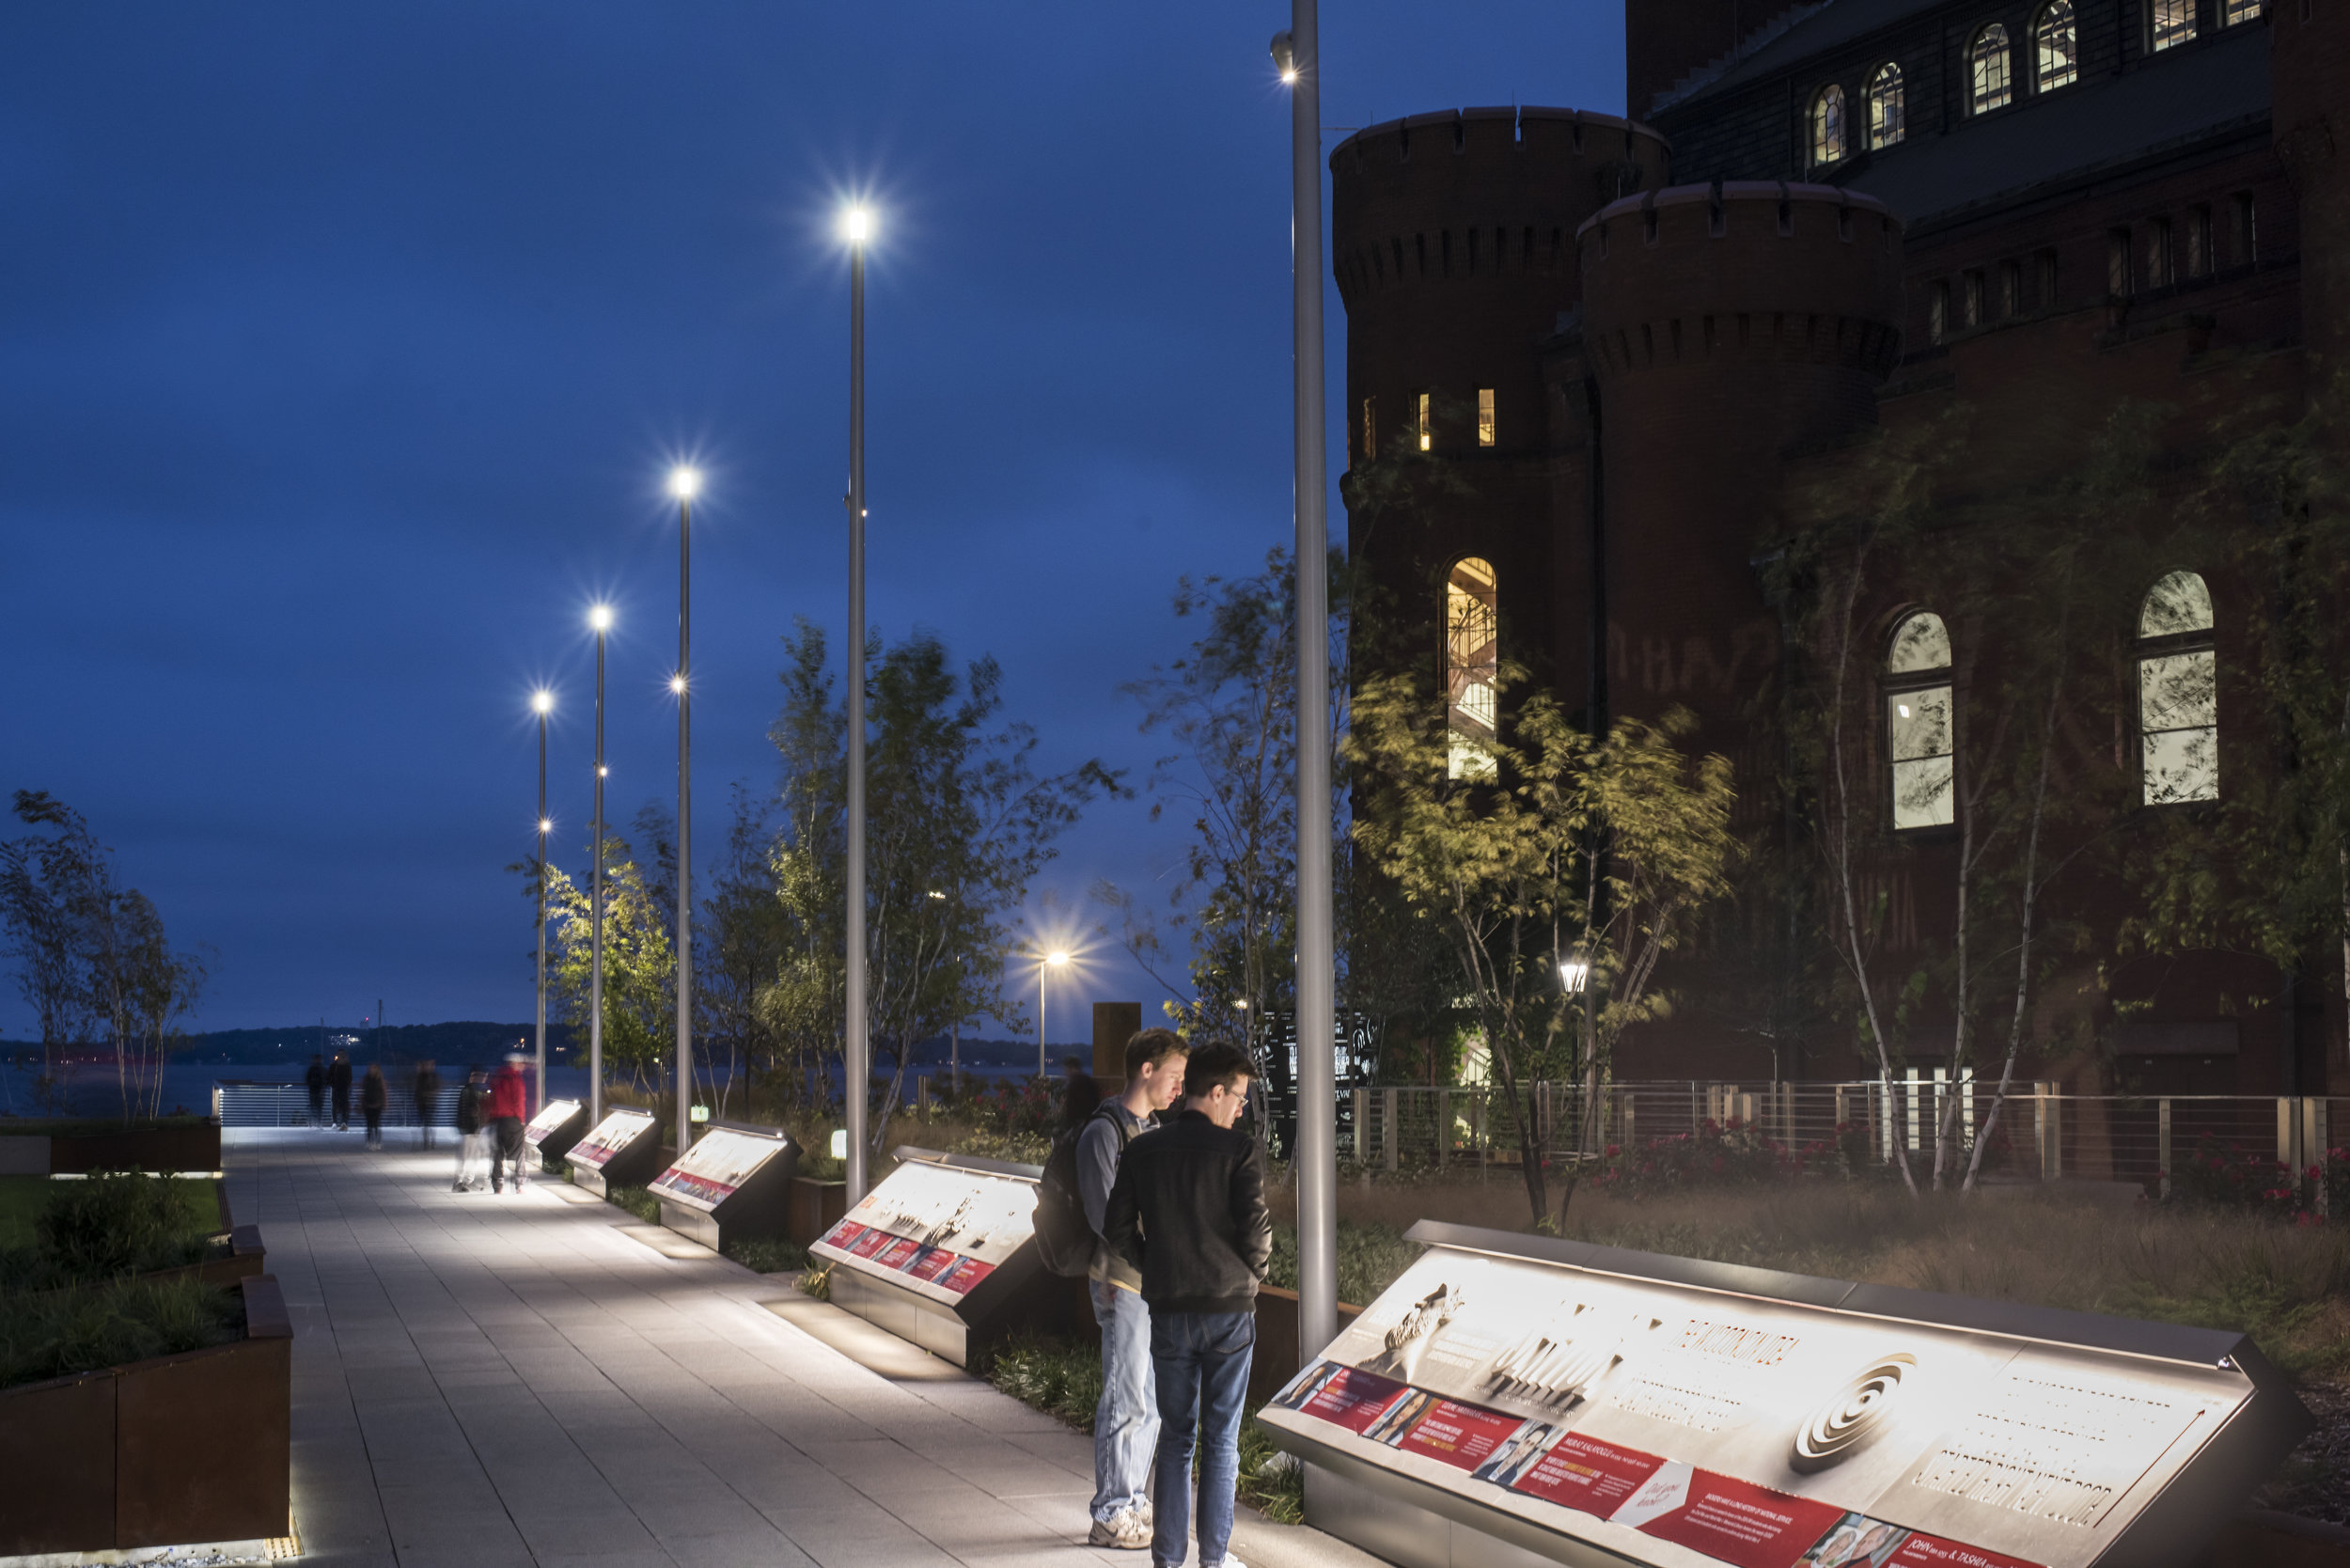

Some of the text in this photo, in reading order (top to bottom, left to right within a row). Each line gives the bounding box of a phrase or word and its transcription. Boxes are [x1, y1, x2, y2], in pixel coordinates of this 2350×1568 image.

[1907, 1539, 1933, 1552] JOHN
[1949, 1549, 1958, 1560] &
[1956, 1552, 1987, 1567] TASHIA
